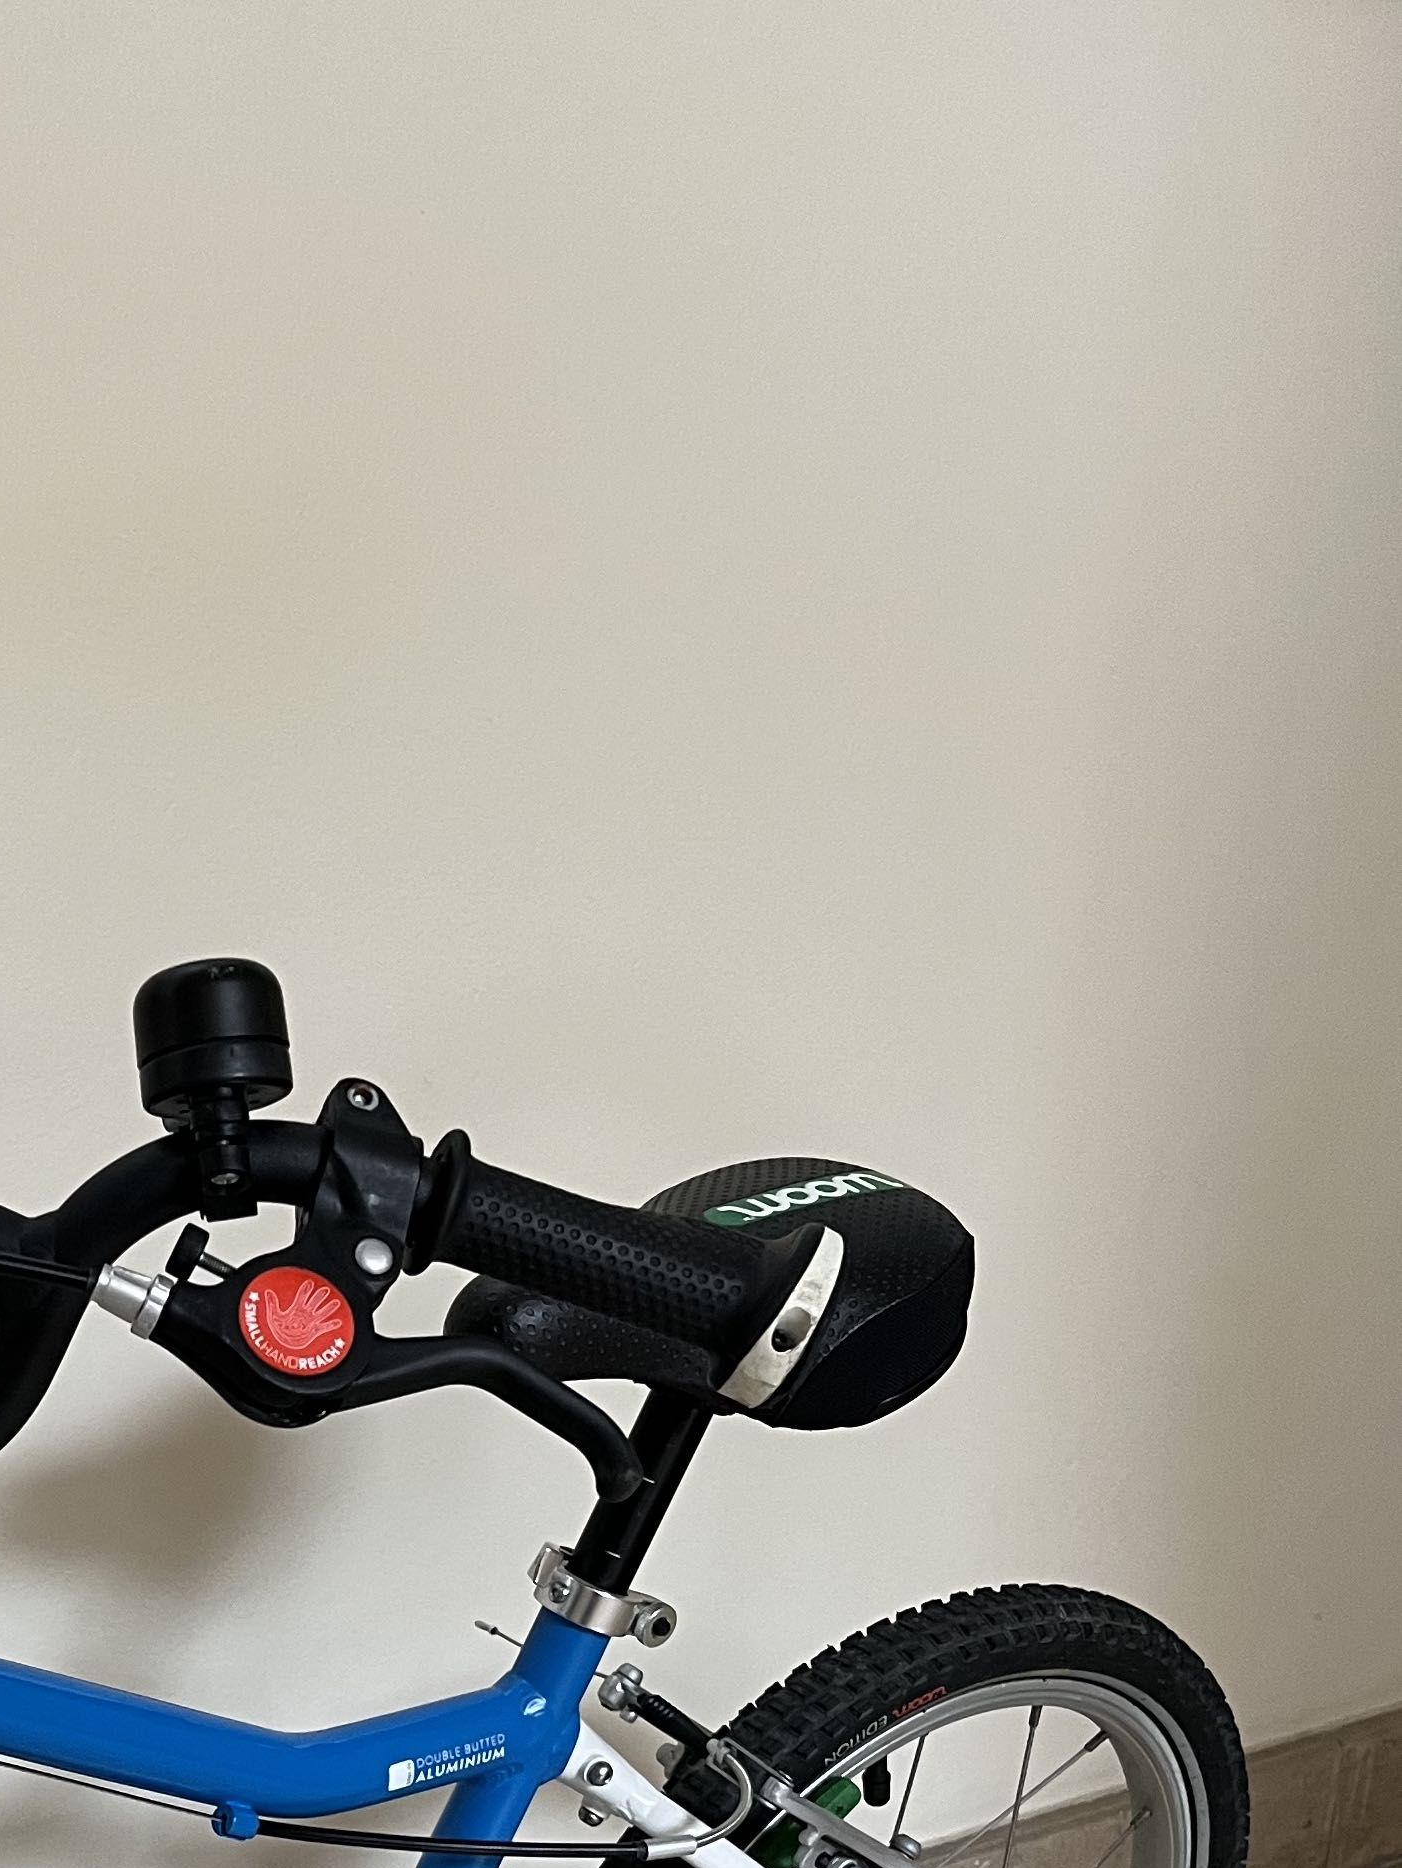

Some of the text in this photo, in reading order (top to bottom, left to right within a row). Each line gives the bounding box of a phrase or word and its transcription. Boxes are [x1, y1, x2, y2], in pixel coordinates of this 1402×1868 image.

[716, 1172, 904, 1218] woom
[416, 1733, 506, 1769] DOUBLE BUTTED
[824, 1714, 888, 1767] EDITION
[415, 1746, 505, 1783] ALUMINIUM
